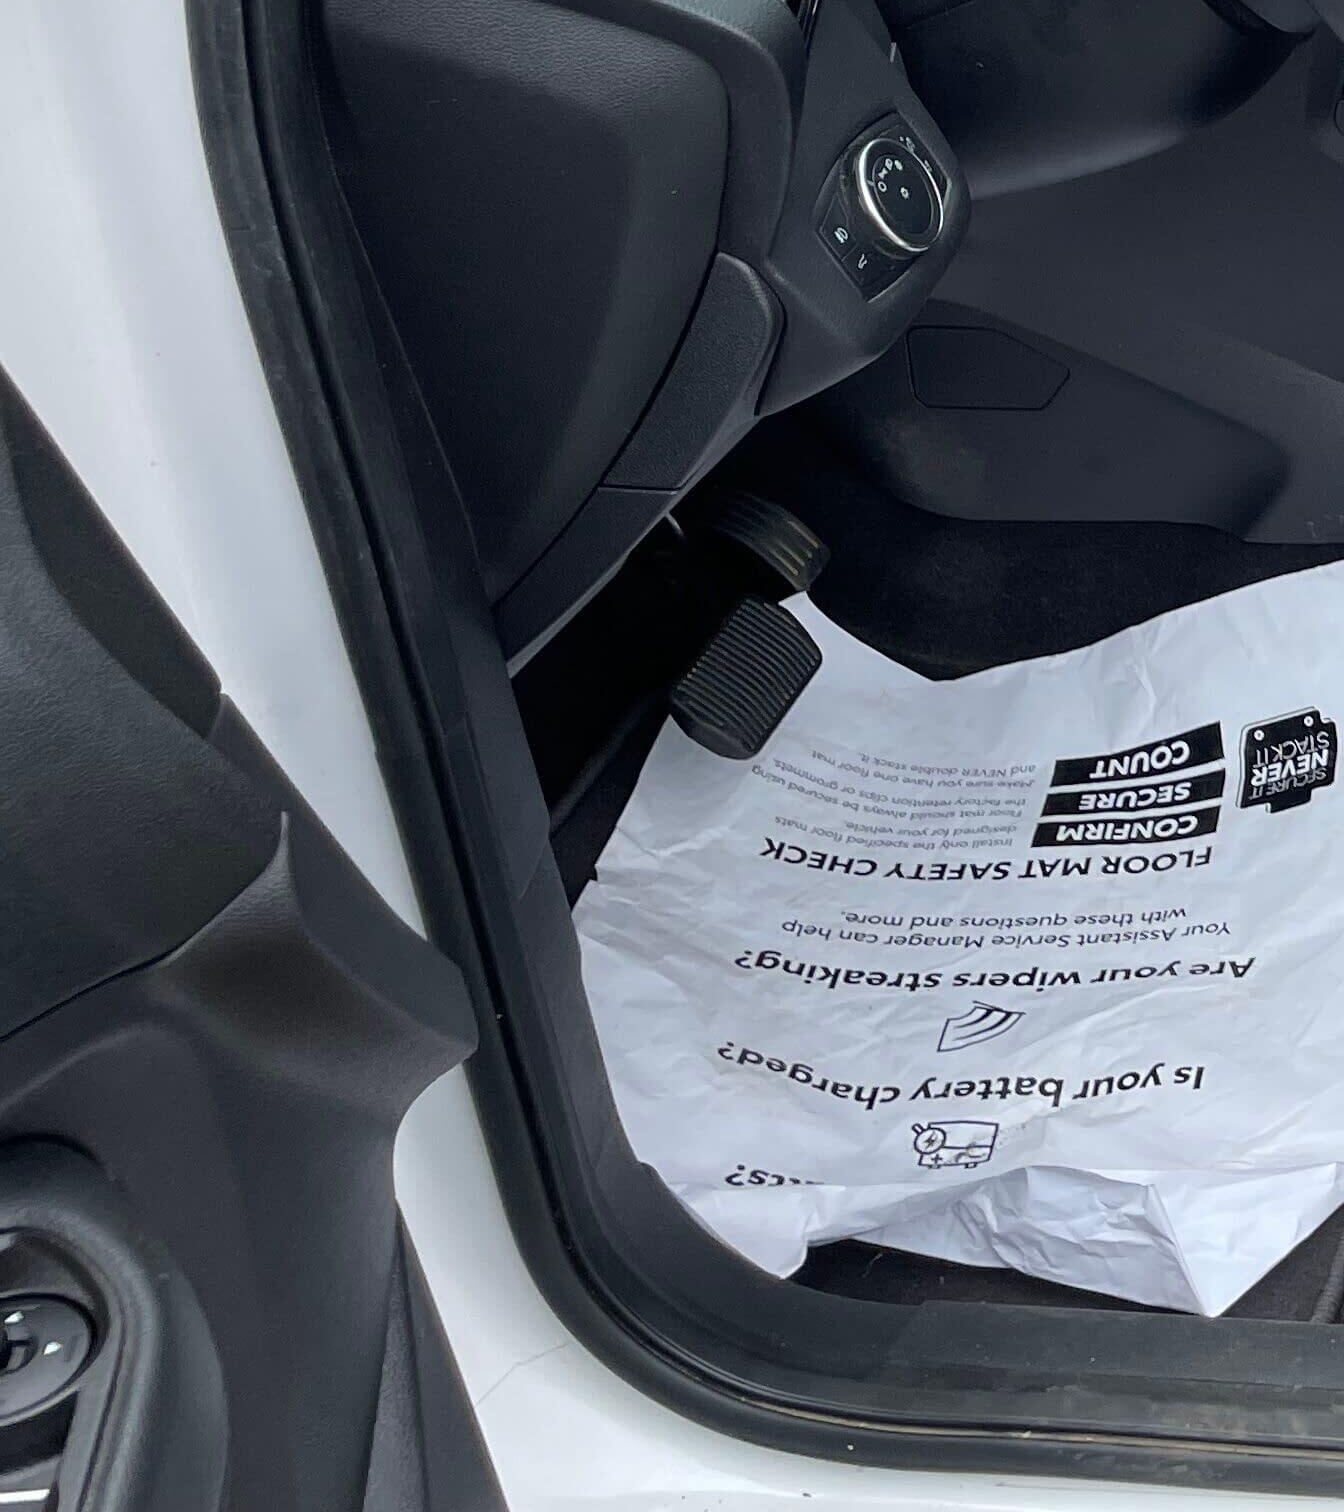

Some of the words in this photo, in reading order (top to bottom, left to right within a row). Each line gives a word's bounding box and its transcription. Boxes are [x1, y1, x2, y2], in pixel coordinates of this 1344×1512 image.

[1270, 730, 1329, 760] STACK
[1088, 739, 1190, 778] COUNT
[1250, 748, 1328, 786] NEVER
[1252, 748, 1269, 768] IT
[751, 764, 785, 785] using
[1264, 767, 1326, 794] SECURE
[787, 782, 837, 804] secured
[1078, 780, 1192, 810] SECURE
[1248, 784, 1261, 800] IT
[774, 816, 807, 831] mats
[897, 827, 928, 836] your
[1056, 814, 1198, 841] CONFIRM
[845, 834, 908, 848] specified
[912, 841, 934, 850] the
[939, 839, 968, 848] only
[971, 838, 1012, 848] Install
[758, 836, 877, 876] CHECK
[1101, 846, 1212, 874] FLOOR
[883, 862, 1011, 880] SAFETY
[1018, 857, 1091, 878] MAT
[840, 911, 903, 927] more.
[909, 916, 953, 930] and
[954, 913, 1067, 929] questions
[1074, 913, 1132, 928] these
[1141, 908, 1185, 923] with
[781, 919, 831, 939] help
[838, 929, 878, 943] can
[1075, 927, 1176, 946] Assistant
[1181, 921, 1230, 936] Your
[883, 932, 984, 948] Manager
[991, 934, 1070, 948] Service
[734, 950, 942, 992] streaking?
[1089, 960, 1180, 983] your
[1189, 956, 1255, 978] Are
[952, 966, 1080, 992] wipers
[717, 1041, 900, 1110] charged?
[1072, 1062, 1164, 1100] your
[1174, 1066, 1204, 1088] Is
[908, 1076, 1064, 1106] battery
